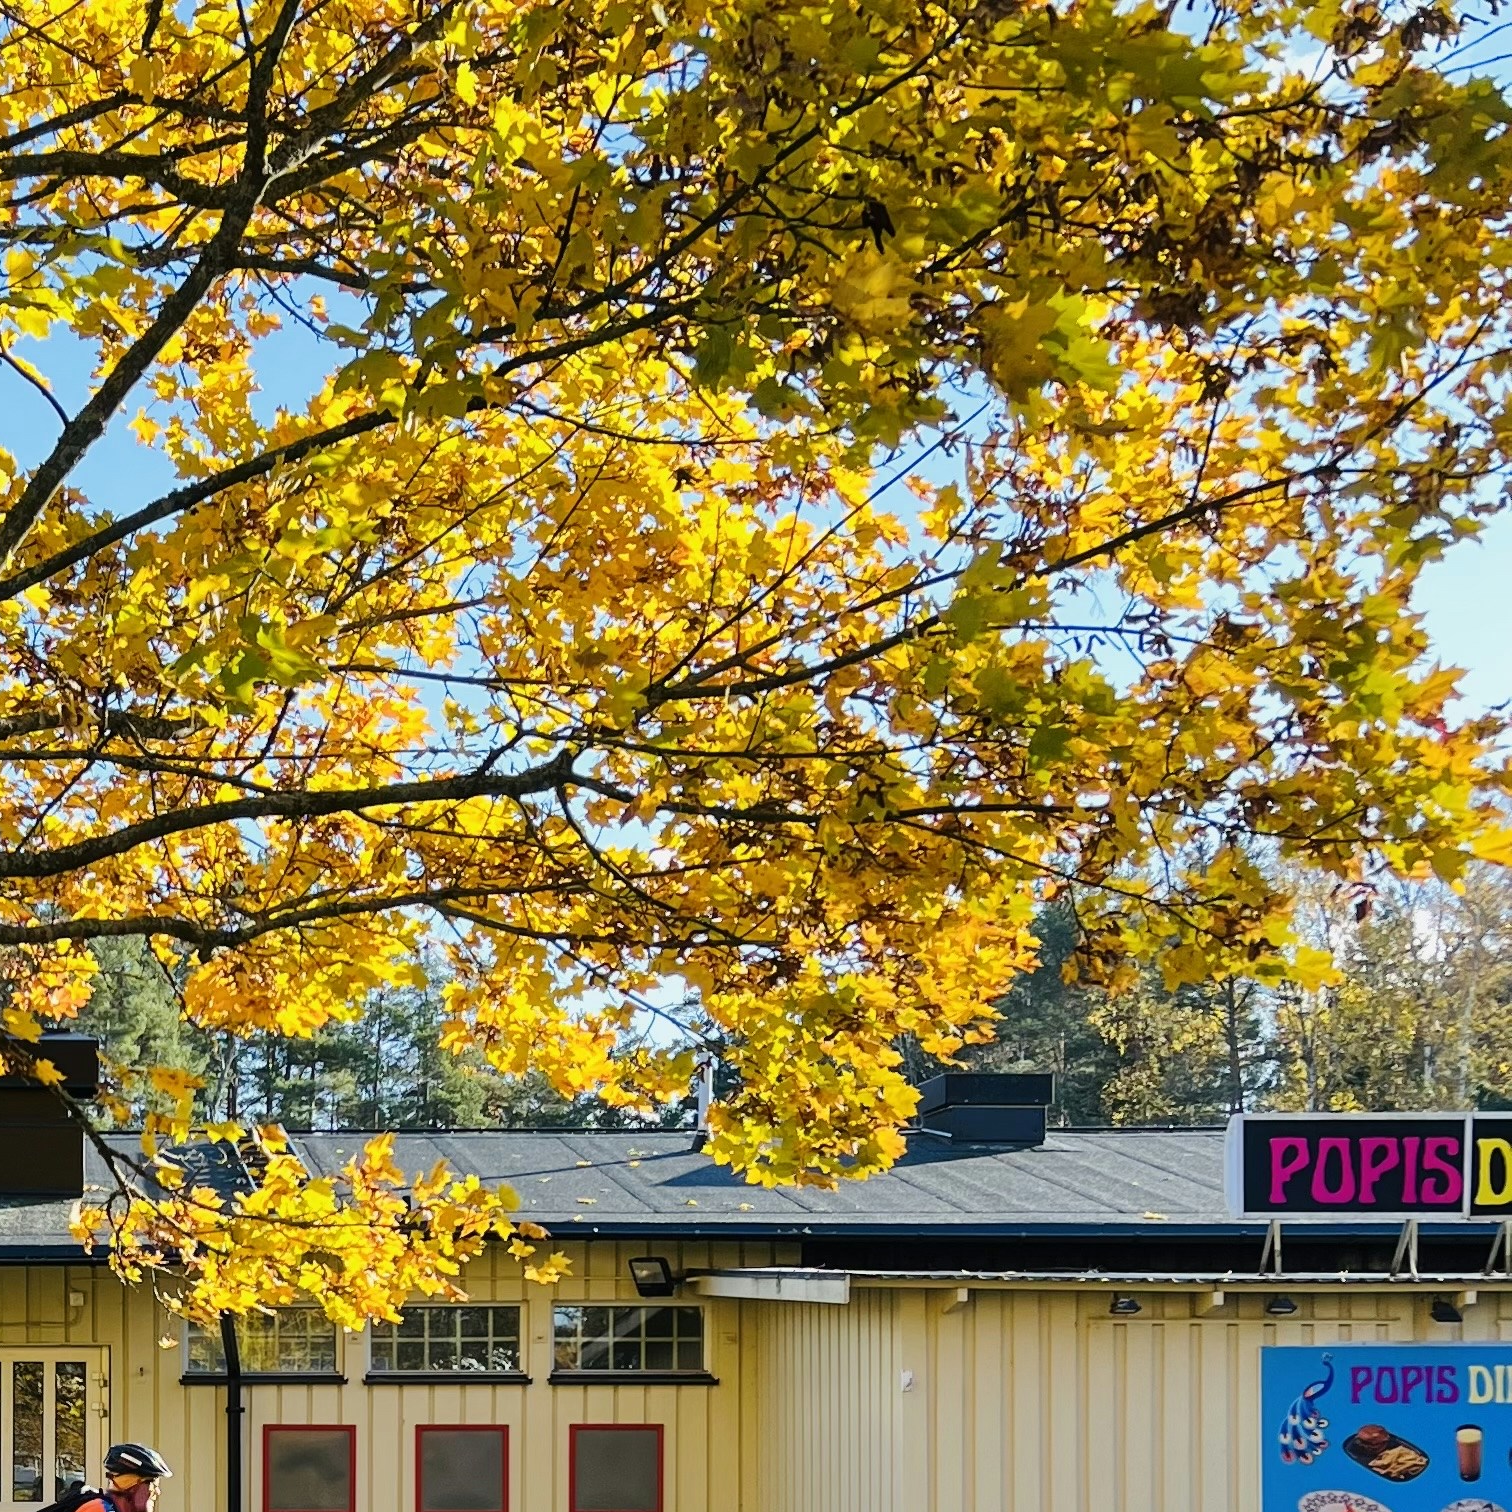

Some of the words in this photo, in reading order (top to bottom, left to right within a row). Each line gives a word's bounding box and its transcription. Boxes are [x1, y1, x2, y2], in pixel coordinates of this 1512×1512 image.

[1268, 1137, 1464, 1204] POPIS
[1350, 1365, 1460, 1404] POPIS
[1468, 1365, 1512, 1404] DI
